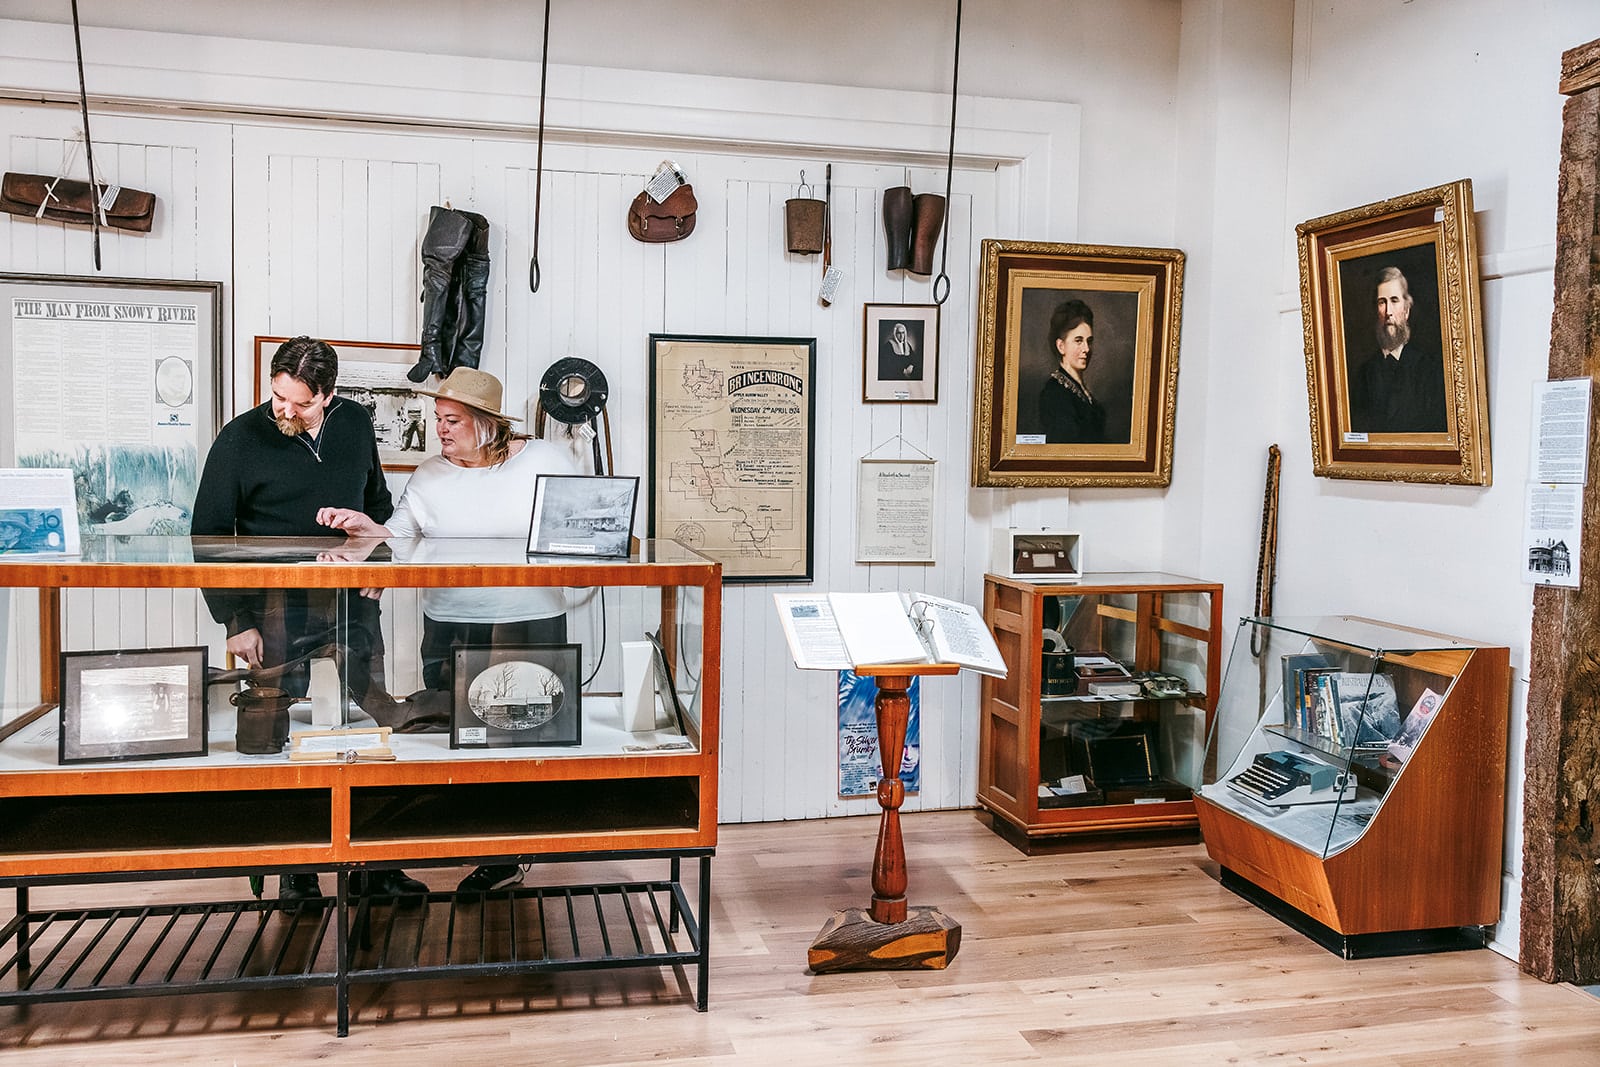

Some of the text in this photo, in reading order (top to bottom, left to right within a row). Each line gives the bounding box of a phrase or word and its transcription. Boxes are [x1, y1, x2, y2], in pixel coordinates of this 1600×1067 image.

[14, 301, 196, 321] THE MAN FROM SNOWY RIVER
[40, 512, 60, 531] 10
